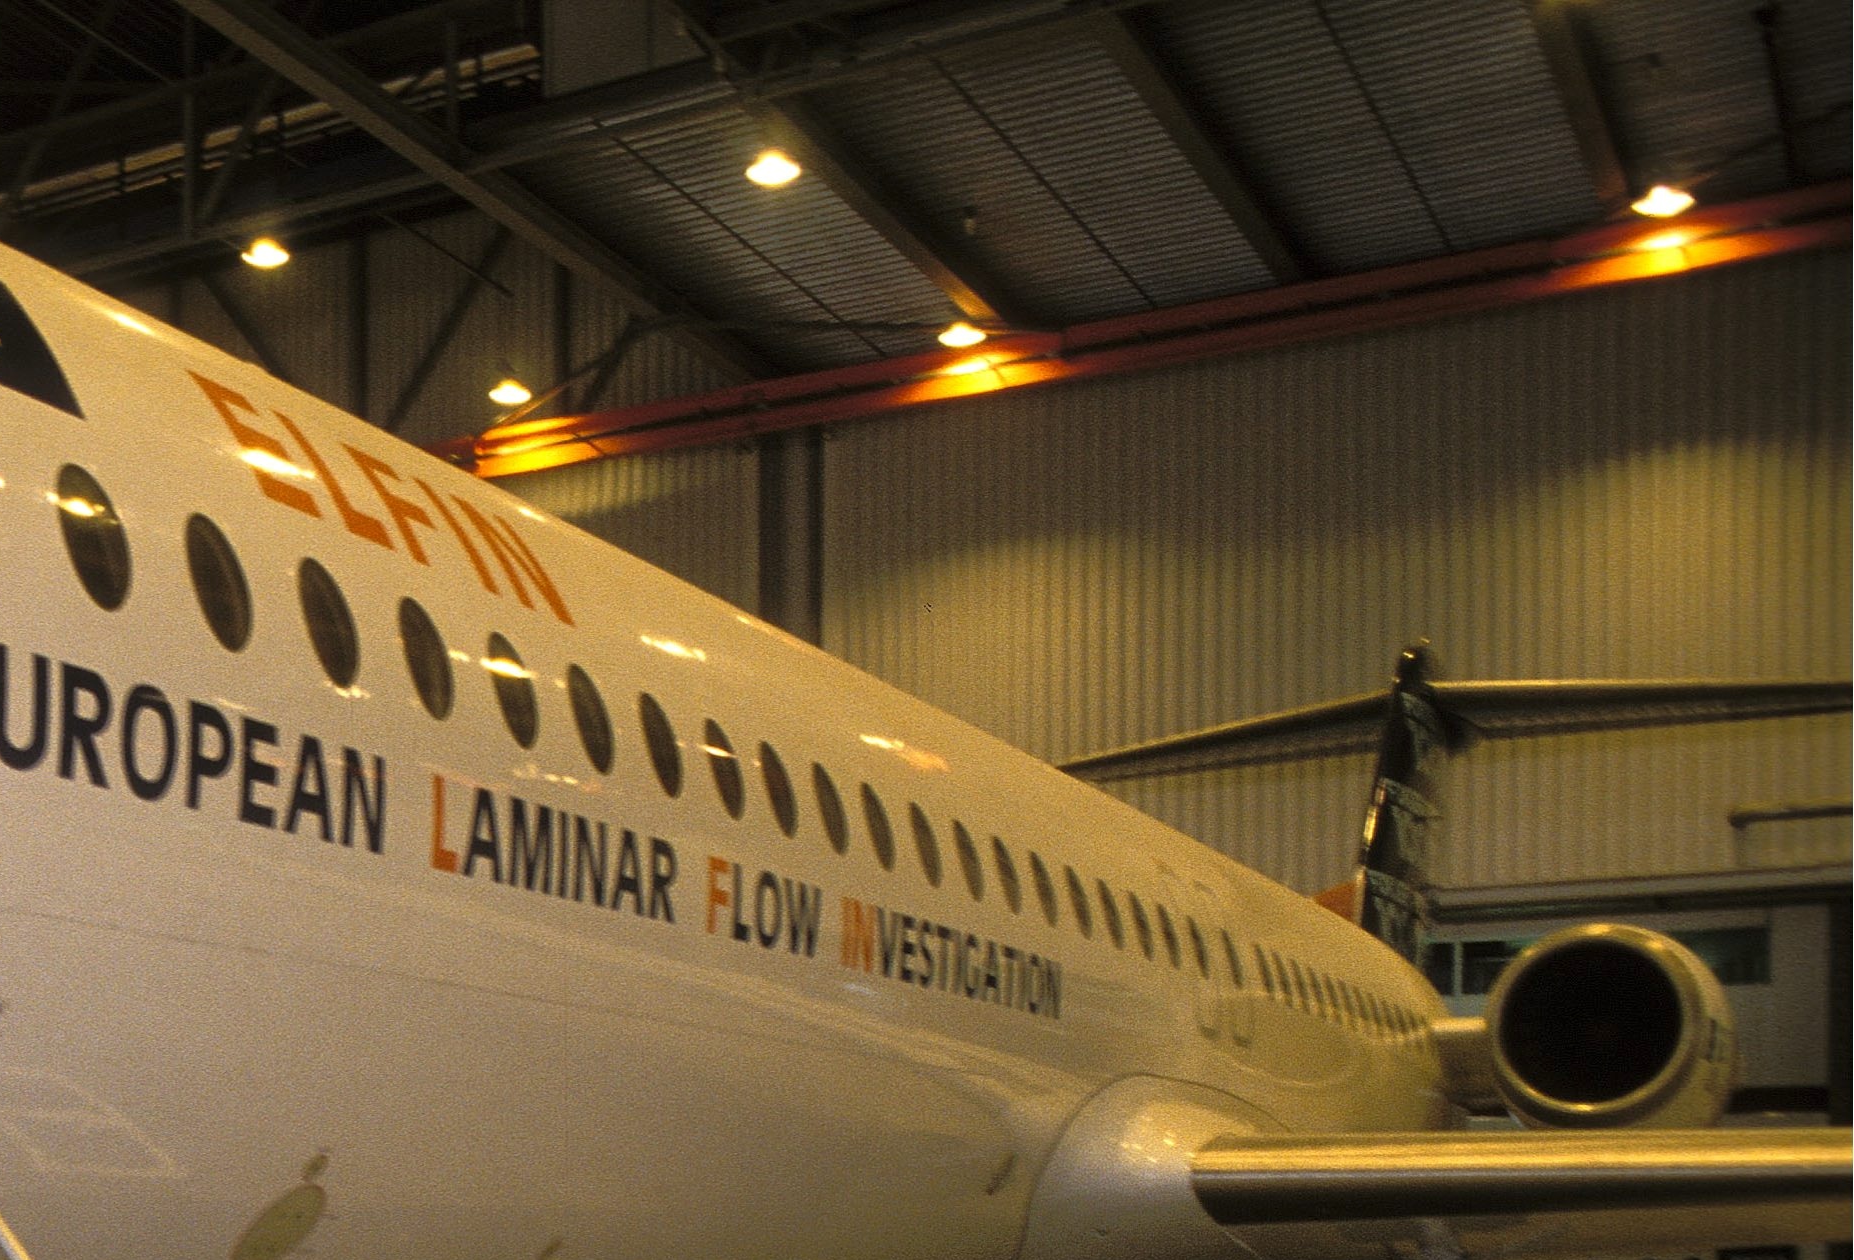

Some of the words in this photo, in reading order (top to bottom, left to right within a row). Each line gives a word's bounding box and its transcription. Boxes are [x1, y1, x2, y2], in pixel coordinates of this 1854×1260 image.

[186, 369, 576, 627] ELFIN
[431, 774, 678, 923] LAMINAR
[705, 855, 821, 957] FLOW
[842, 897, 1063, 1020] INVESTIGATION
